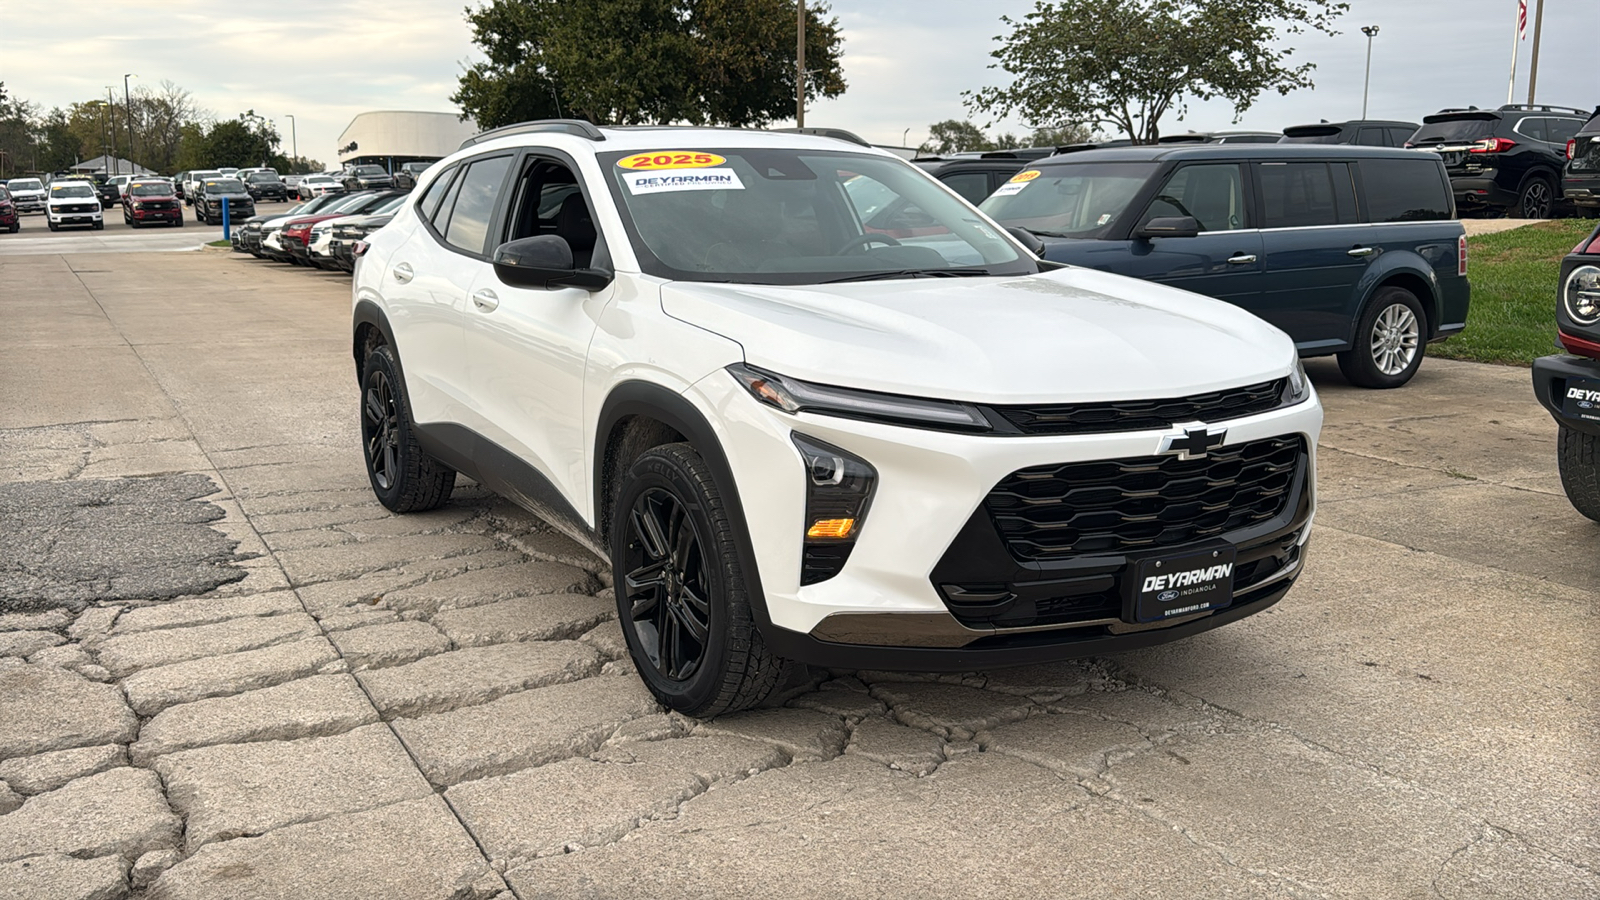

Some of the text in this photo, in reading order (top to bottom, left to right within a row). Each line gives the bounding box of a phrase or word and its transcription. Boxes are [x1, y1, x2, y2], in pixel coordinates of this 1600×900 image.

[632, 154, 712, 168] 2025
[635, 175, 731, 187] DEYARMAN
[644, 181, 685, 189] CERTIFIED
[647, 460, 679, 482] KELLY
[1141, 562, 1233, 593] DEYARMAN
[1160, 584, 1217, 600] Ford INDIANOLA
[1164, 602, 1210, 616] DEYARMANFORD.COM
